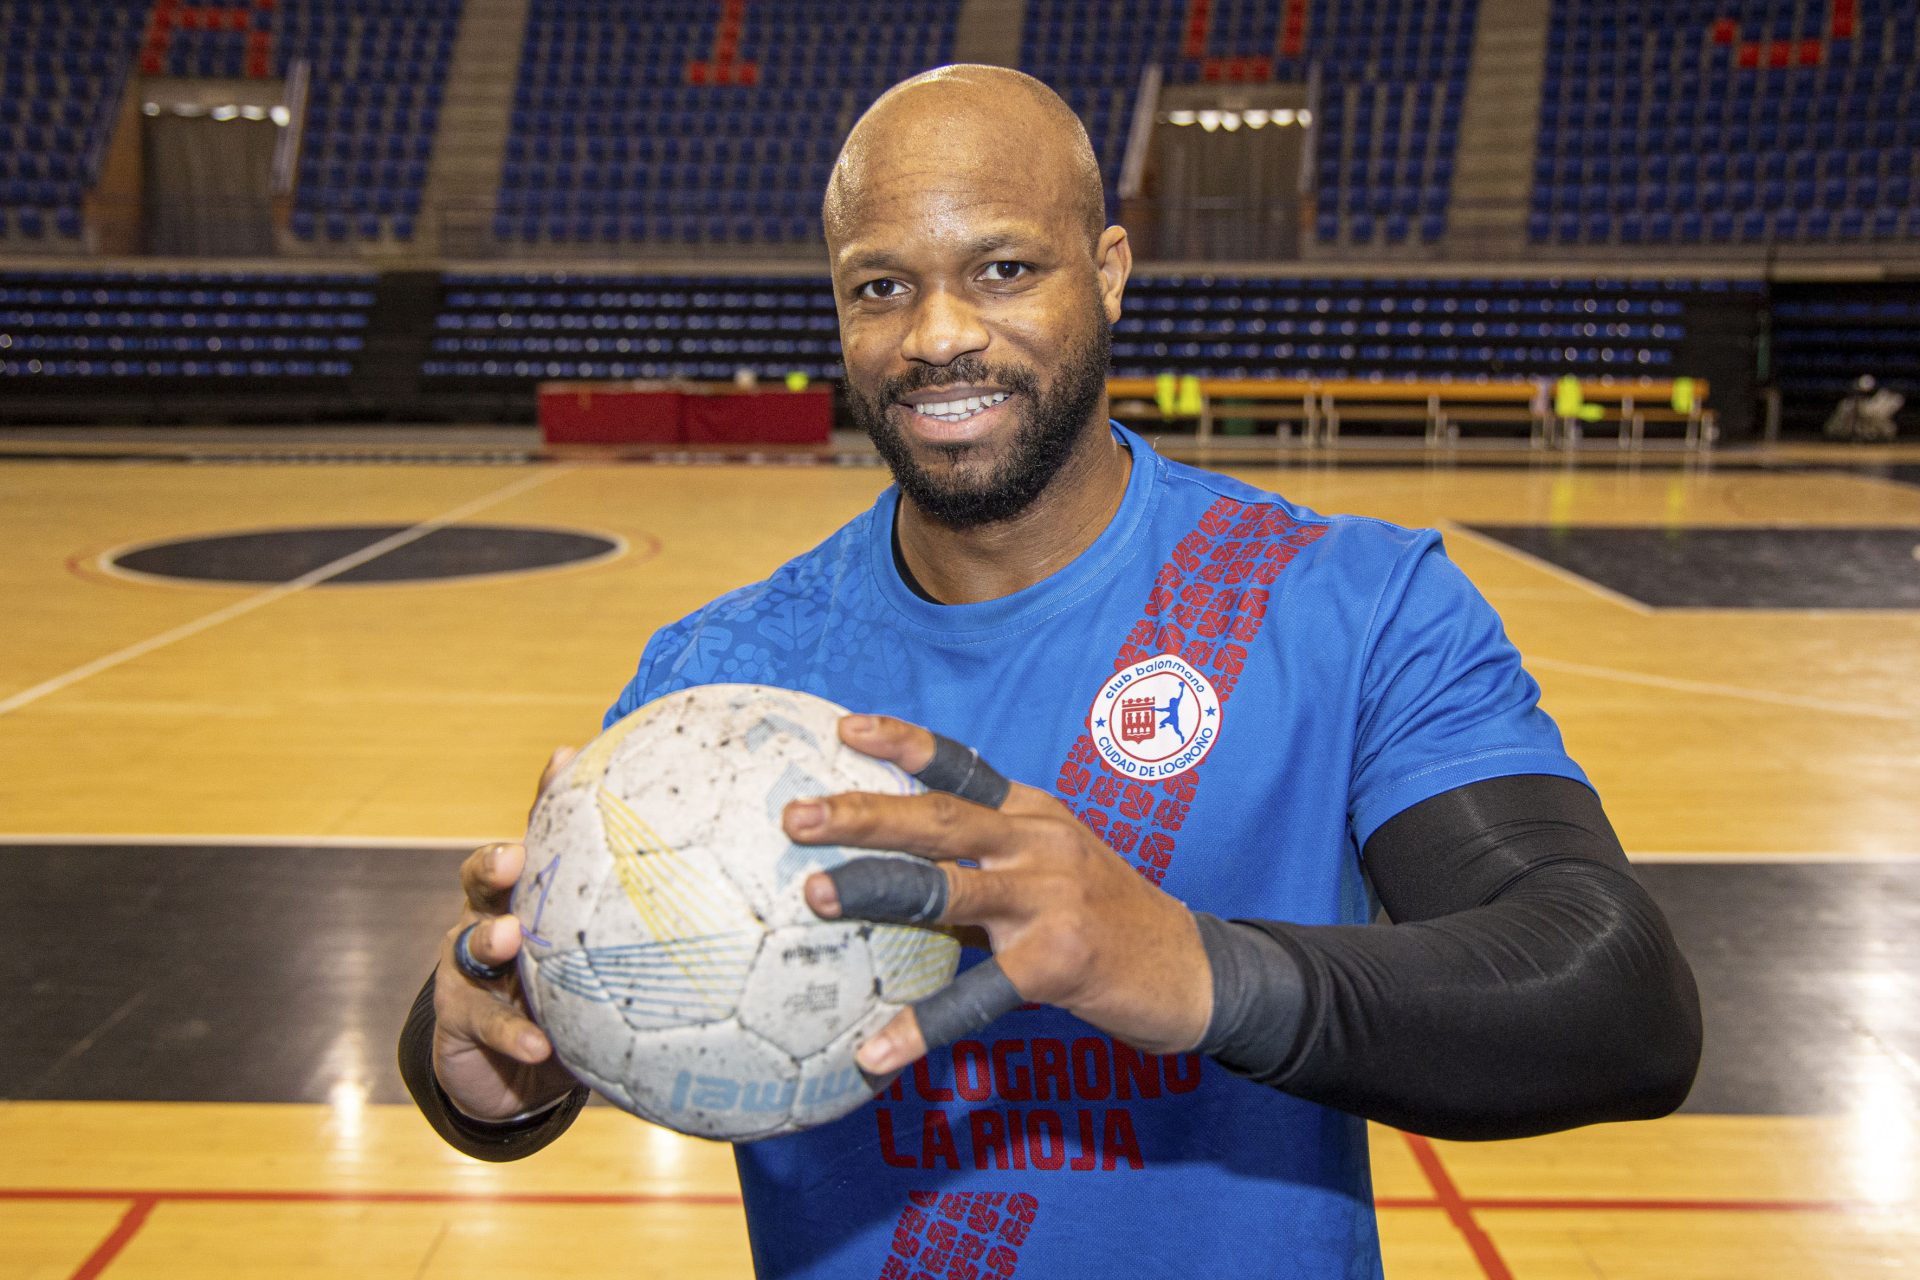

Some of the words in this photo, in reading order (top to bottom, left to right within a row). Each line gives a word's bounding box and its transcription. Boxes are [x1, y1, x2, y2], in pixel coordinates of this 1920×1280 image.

[1105, 673, 1132, 699] club
[1135, 660, 1205, 693] balonmano
[1098, 736, 1136, 773] CIUDAD
[1139, 765, 1155, 777] DE
[1159, 727, 1213, 775] LOGROÑO
[876, 1108, 961, 1169] LA
[969, 1108, 1144, 1171] RIOJA
